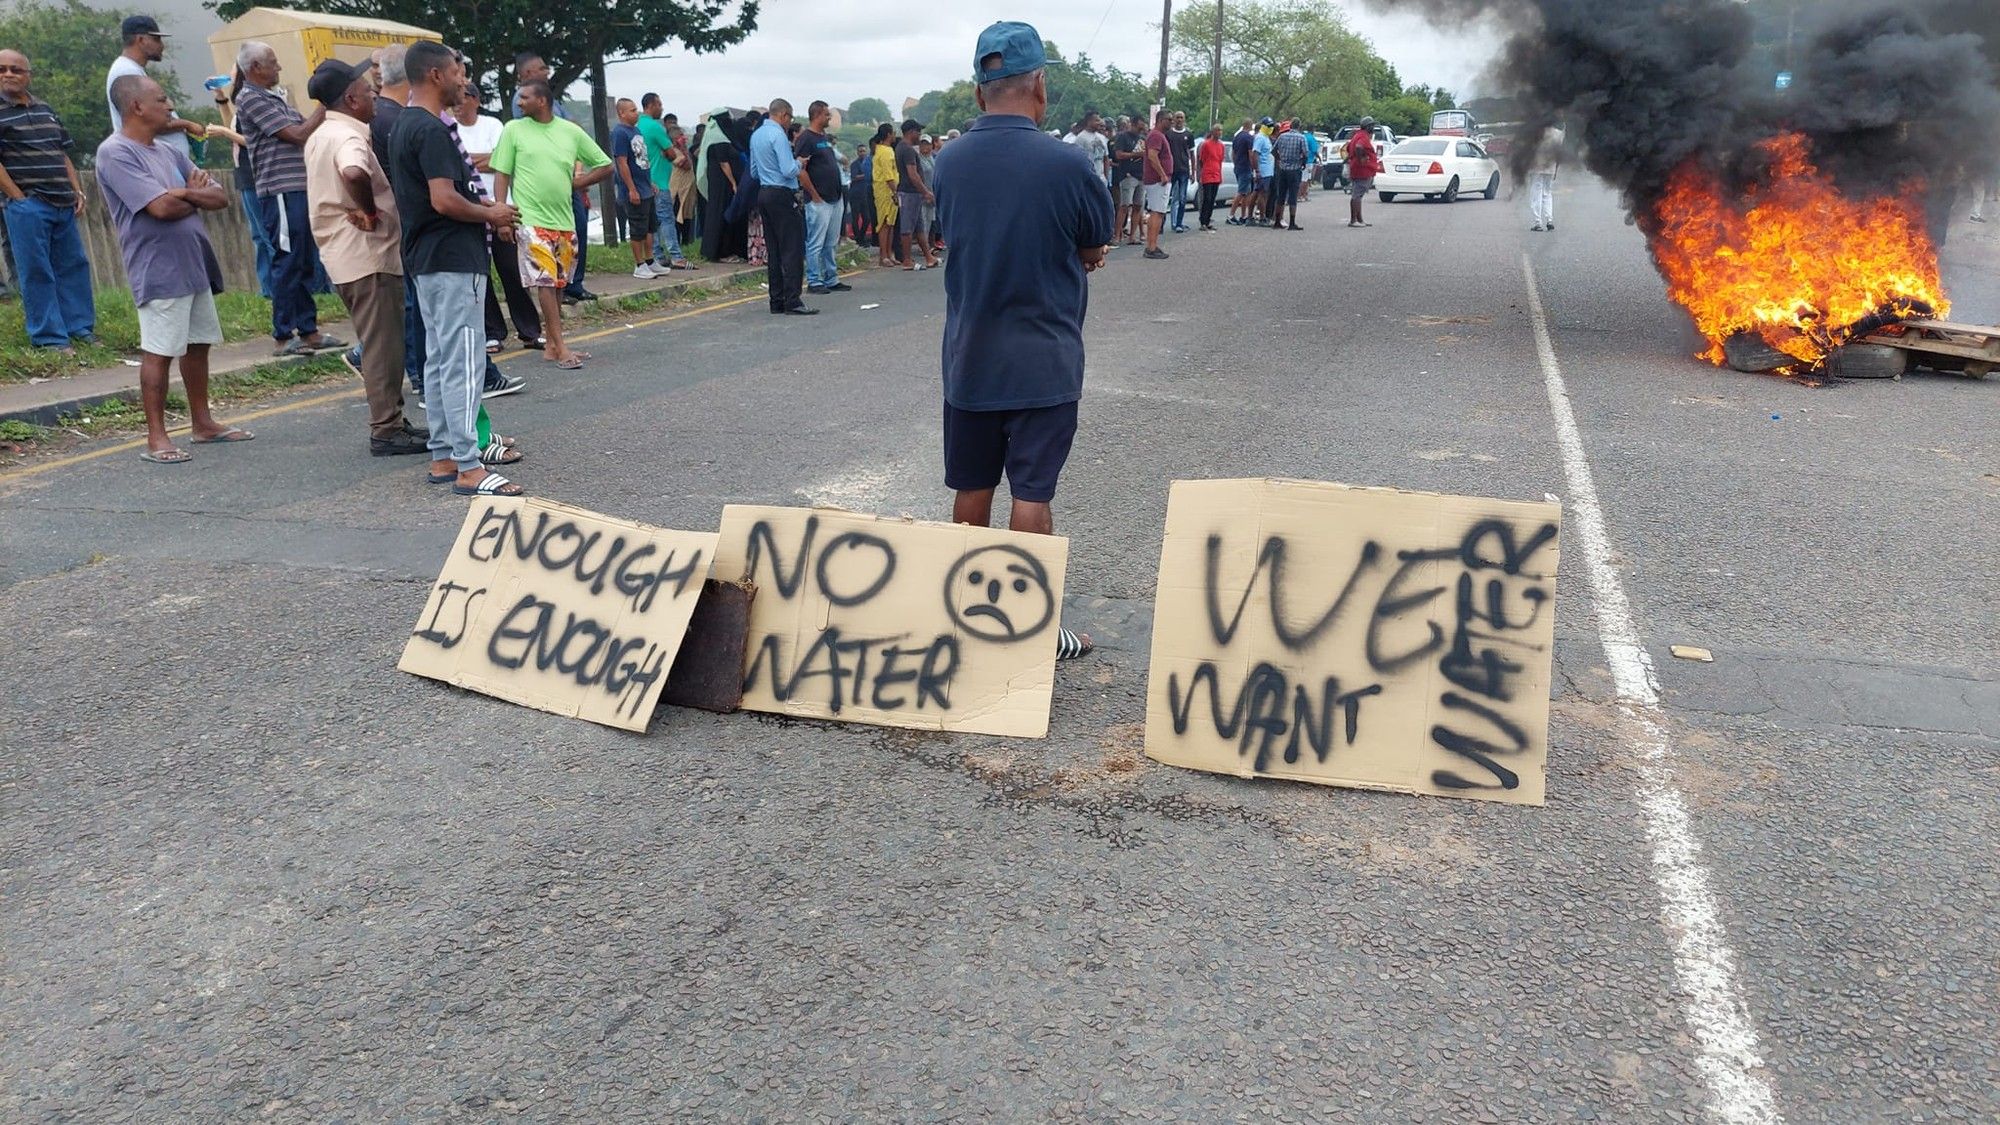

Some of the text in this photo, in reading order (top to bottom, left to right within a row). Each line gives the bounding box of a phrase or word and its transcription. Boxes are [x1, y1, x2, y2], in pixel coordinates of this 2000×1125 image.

[469, 506, 702, 613] ENOUGH
[746, 516, 896, 607] NO
[1205, 532, 1461, 674] WE
[413, 580, 667, 721] IS ENOUGH
[743, 627, 961, 712] WATER
[1431, 517, 1558, 791] WATER
[1169, 662, 1382, 772] WANT
